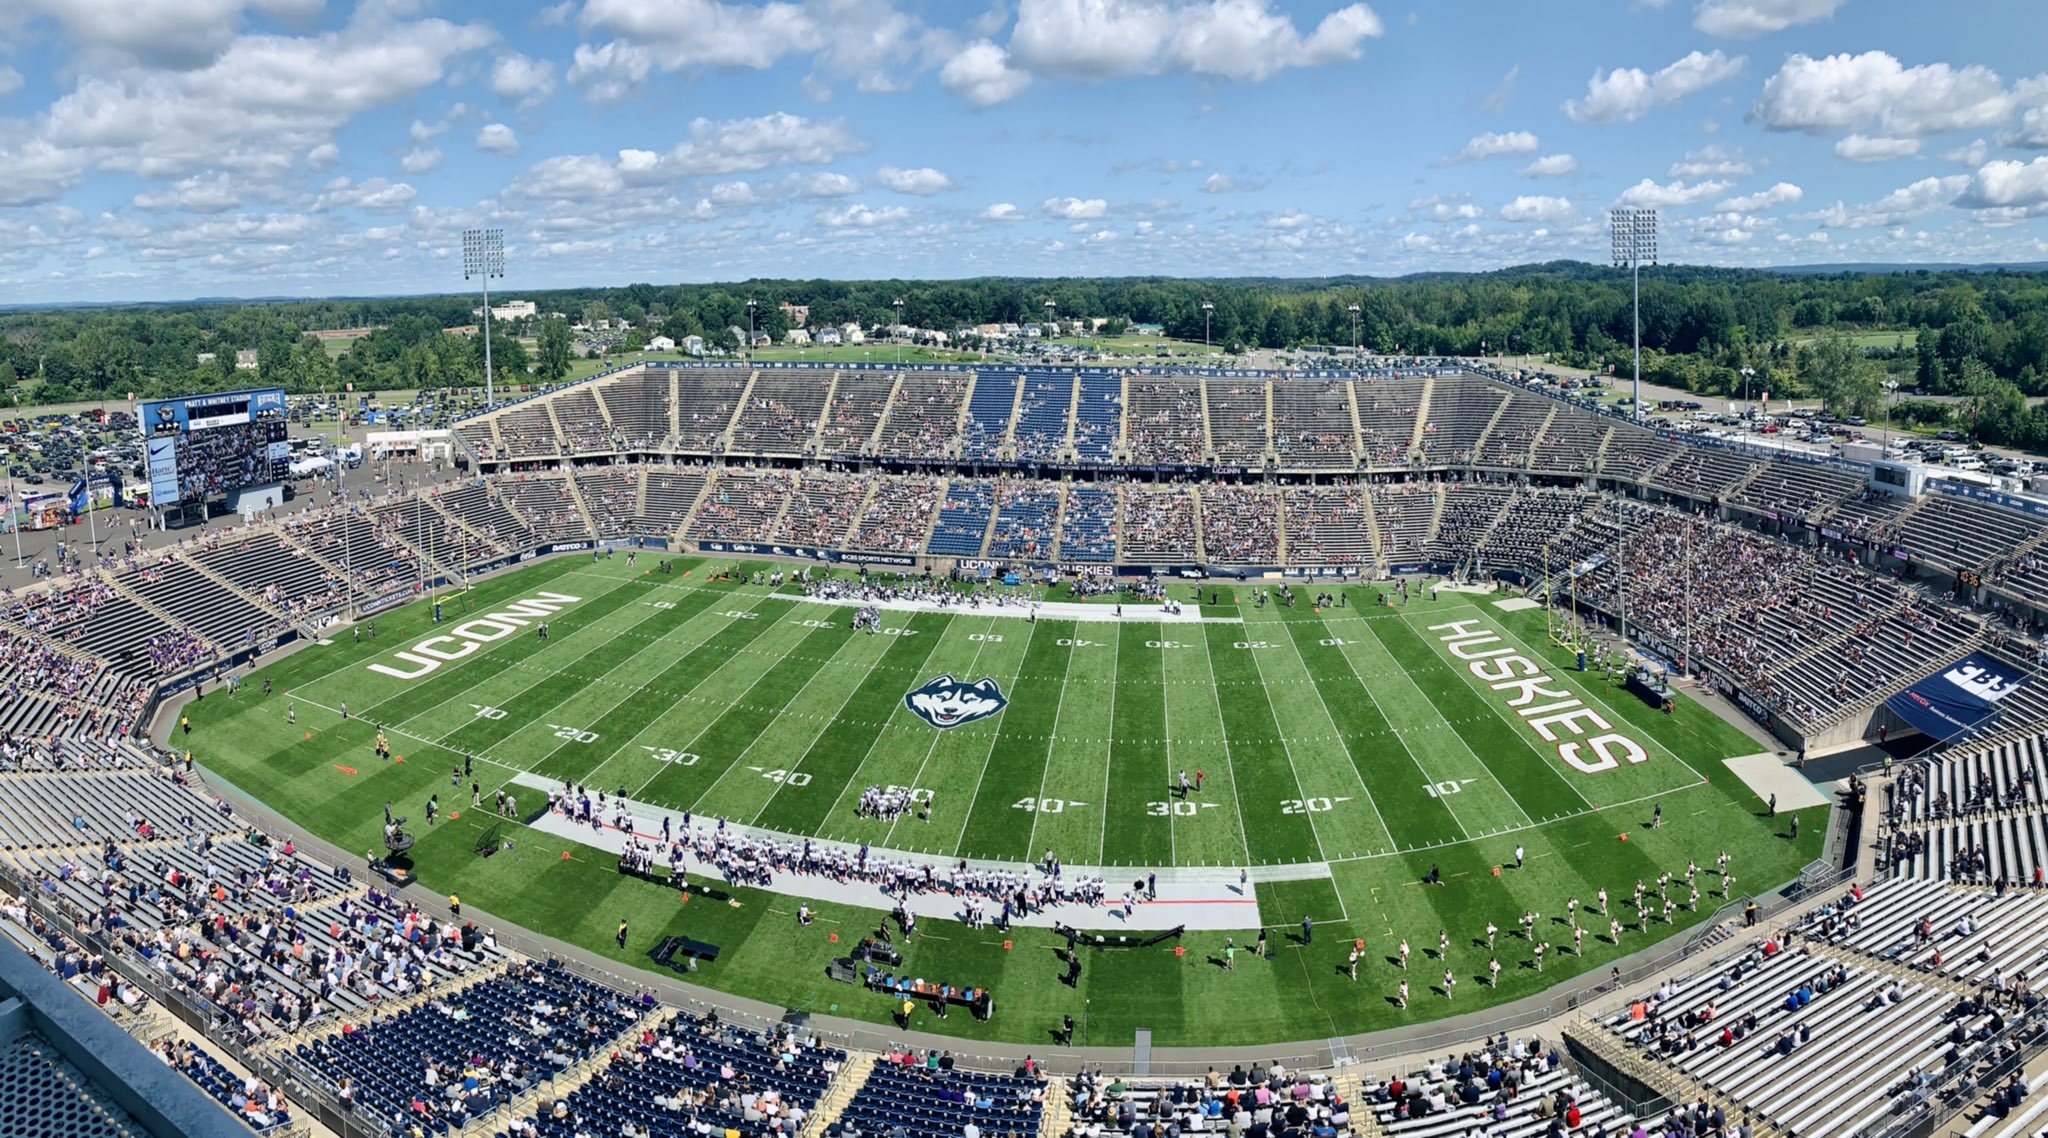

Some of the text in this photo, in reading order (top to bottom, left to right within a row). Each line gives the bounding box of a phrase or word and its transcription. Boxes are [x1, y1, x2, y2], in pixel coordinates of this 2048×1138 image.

[185, 400, 200, 408] PRATT
[208, 397, 231, 405] WHITNEY
[552, 543, 582, 551] DATTCO
[859, 555, 880, 563] SPORTS
[881, 556, 912, 564] NETWORK
[362, 588, 414, 610] UCONNTICKETS.COM
[652, 602, 678, 610] 10
[726, 610, 760, 620] 20
[801, 620, 836, 629] 30
[366, 591, 582, 679] UCONN
[884, 628, 920, 637] 40
[968, 633, 1003, 642] 50
[258, 639, 278, 651] UCONN
[1056, 638, 1092, 647] 40
[1145, 640, 1184, 648] 30
[1233, 641, 1270, 649] 20
[1319, 638, 1346, 646] 10
[1708, 670, 1733, 694] UCONN
[1943, 661, 2021, 701] CBS
[1427, 619, 1648, 774] HUSKIES
[1738, 692, 1762, 715] DATTCO
[475, 707, 508, 721] 10
[554, 726, 599, 743] 20
[652, 748, 700, 766] 30
[761, 768, 813, 786] 40
[1422, 780, 1462, 798] 10
[1012, 797, 1064, 813] 40
[1147, 802, 1198, 816] 30
[1280, 797, 1333, 814] 20
